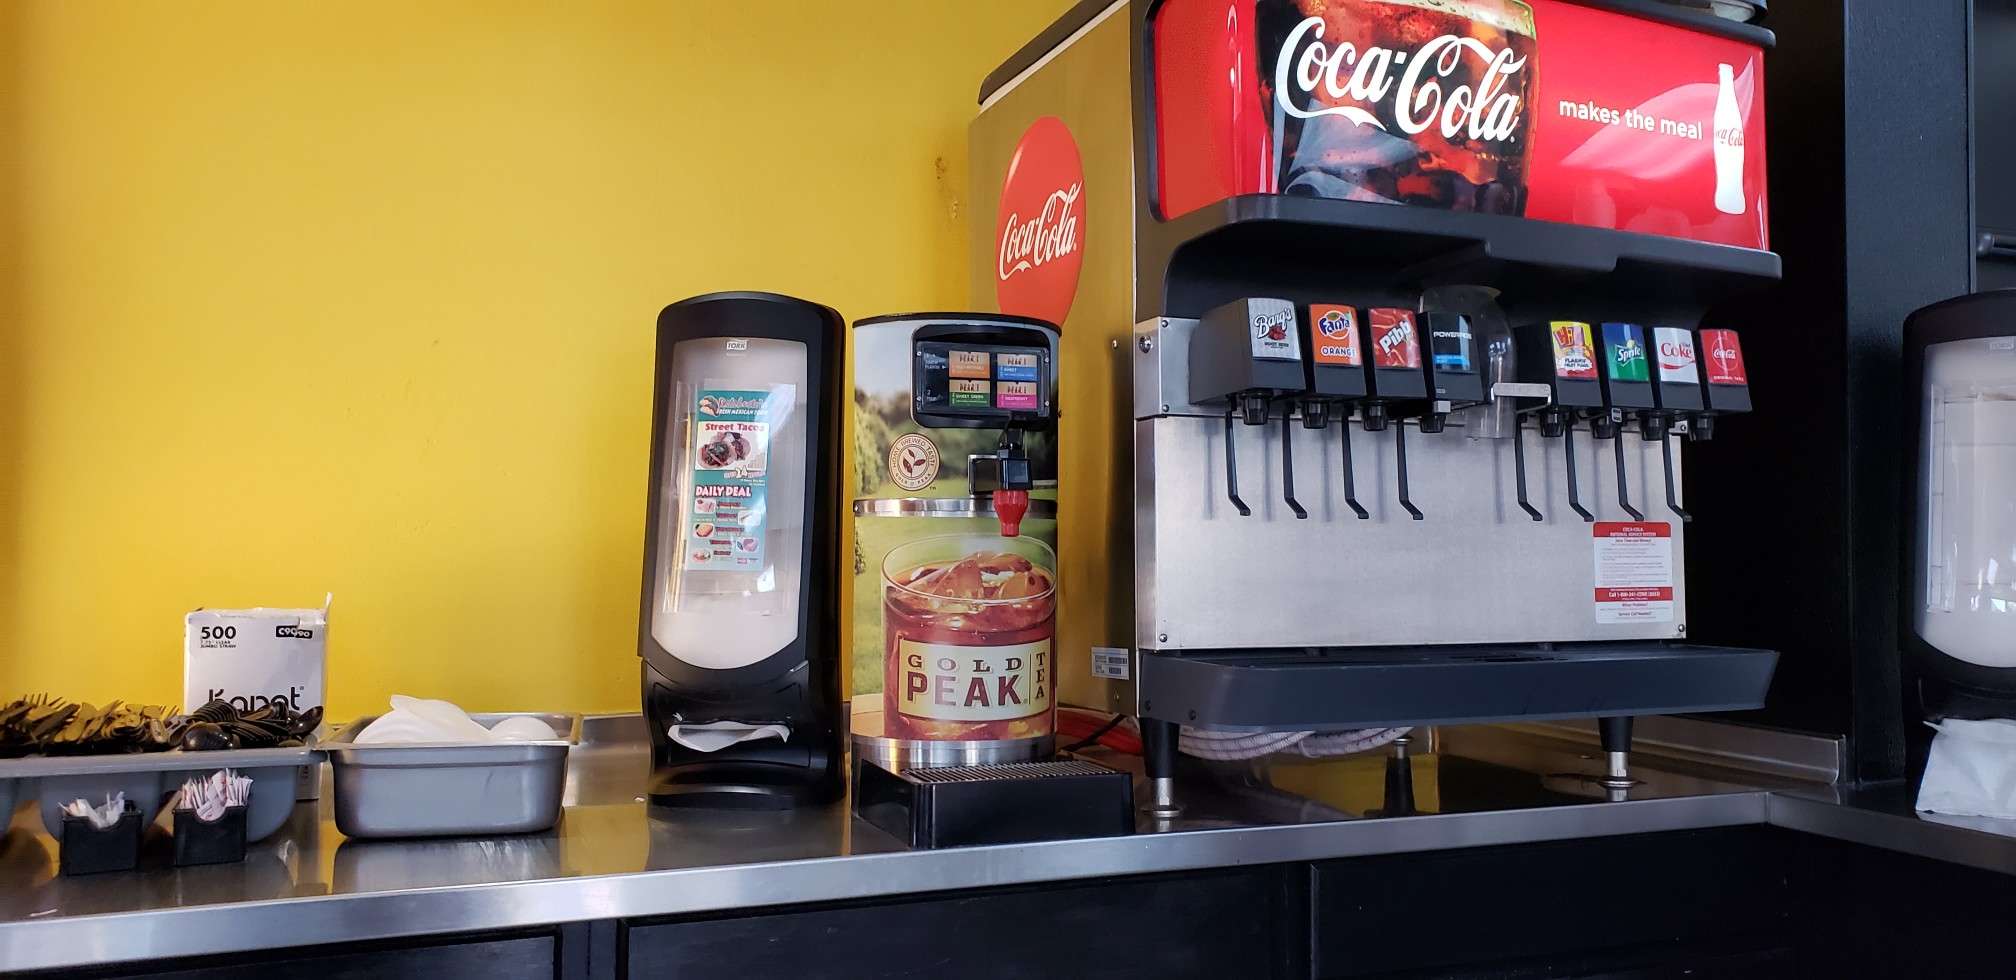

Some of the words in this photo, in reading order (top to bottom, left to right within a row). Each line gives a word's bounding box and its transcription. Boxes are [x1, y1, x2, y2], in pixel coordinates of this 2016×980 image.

[1275, 16, 1527, 142] Coca-Cola
[1559, 100, 1620, 125] makes
[1625, 108, 1655, 132] the
[1660, 117, 1703, 140] meal
[999, 179, 1083, 280] Coca-Cola
[1254, 308, 1292, 339] Barq's
[1318, 316, 1351, 336] Fanta
[1379, 321, 1413, 356] Pibb
[1321, 346, 1357, 357] ORANGE
[1617, 346, 1641, 362] Sprite
[1660, 342, 1692, 358] Coke
[705, 423, 734, 431] Street
[737, 423, 765, 432] Tacos
[900, 437, 926, 447] BREWED
[695, 486, 723, 497] DAILY
[725, 486, 752, 498] DEAL
[201, 626, 237, 639] 500
[907, 654, 1022, 673] GOLD
[1035, 652, 1046, 700] TEA
[906, 671, 1022, 707] PEAK
